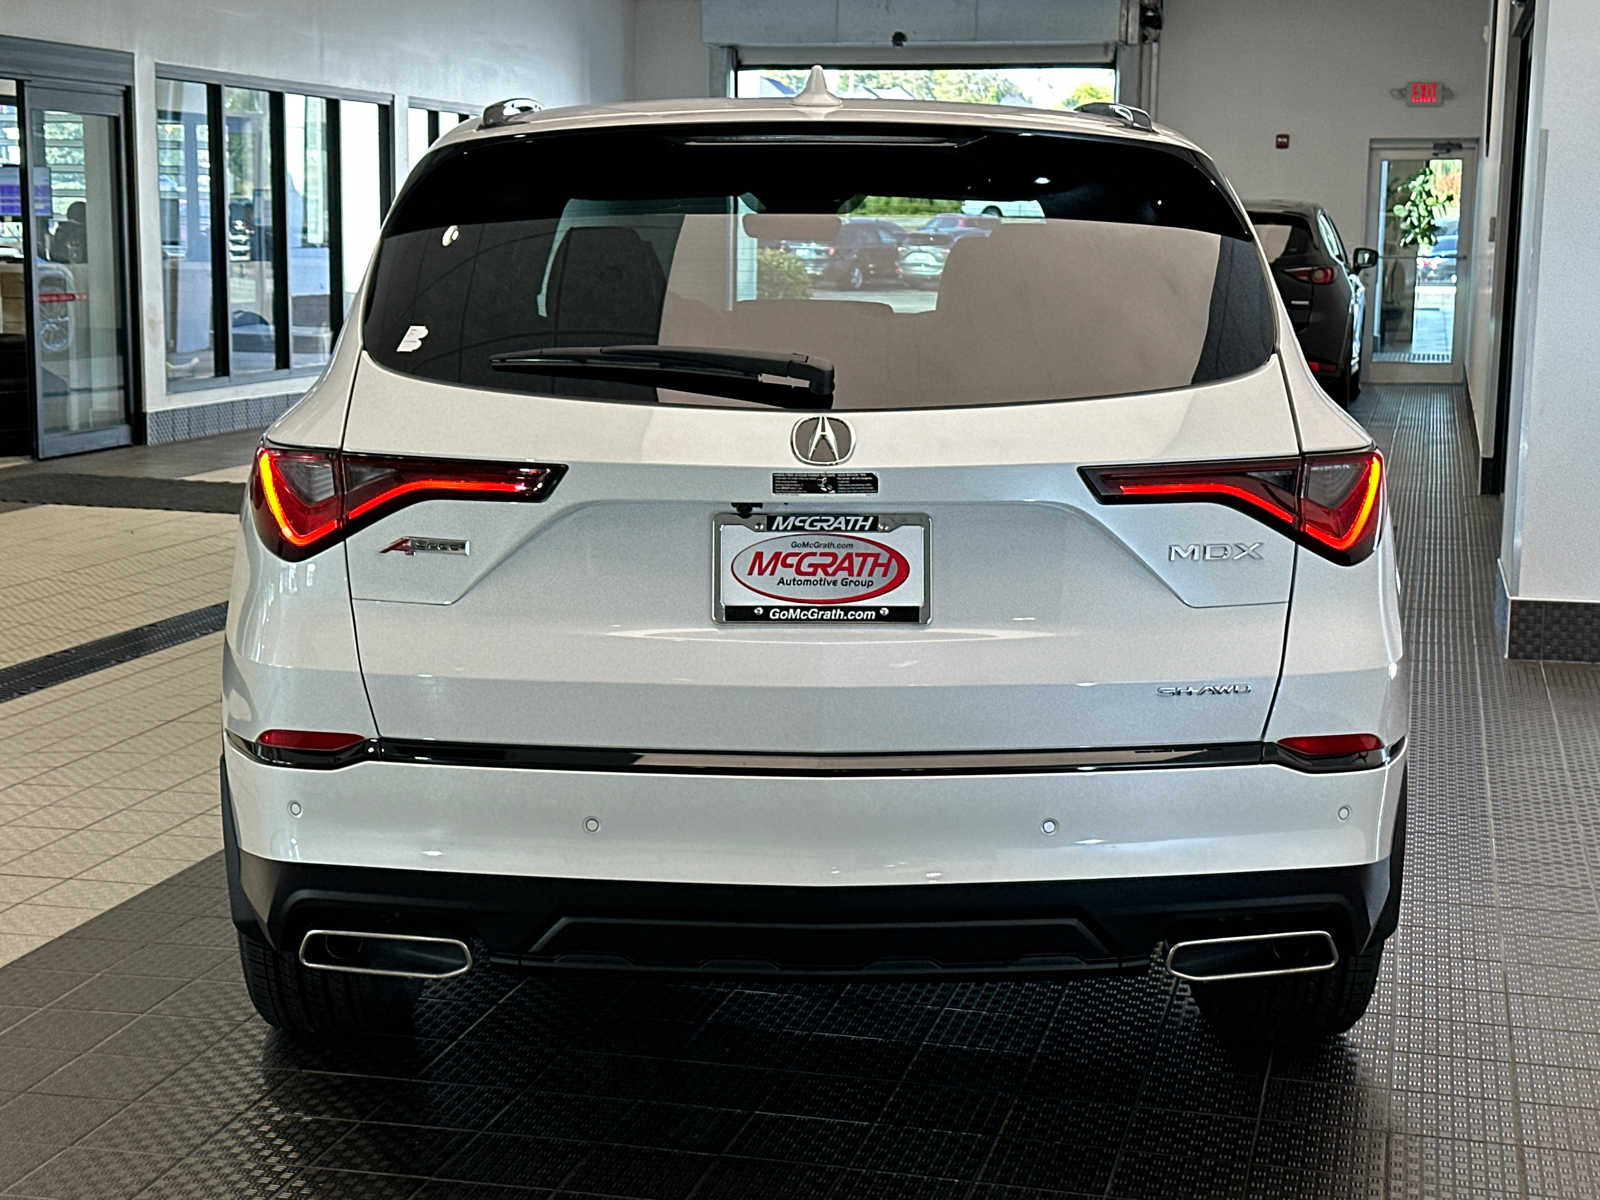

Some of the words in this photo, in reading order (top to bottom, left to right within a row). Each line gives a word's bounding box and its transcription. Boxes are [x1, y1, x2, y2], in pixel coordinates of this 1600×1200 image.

[1412, 83, 1438, 103] EXIT
[790, 541, 854, 549] GoMcGrath.com
[1168, 542, 1264, 561] MDX
[777, 577, 838, 587] Automotive
[841, 578, 874, 588] Group
[769, 608, 876, 619] GoMcGrath.com
